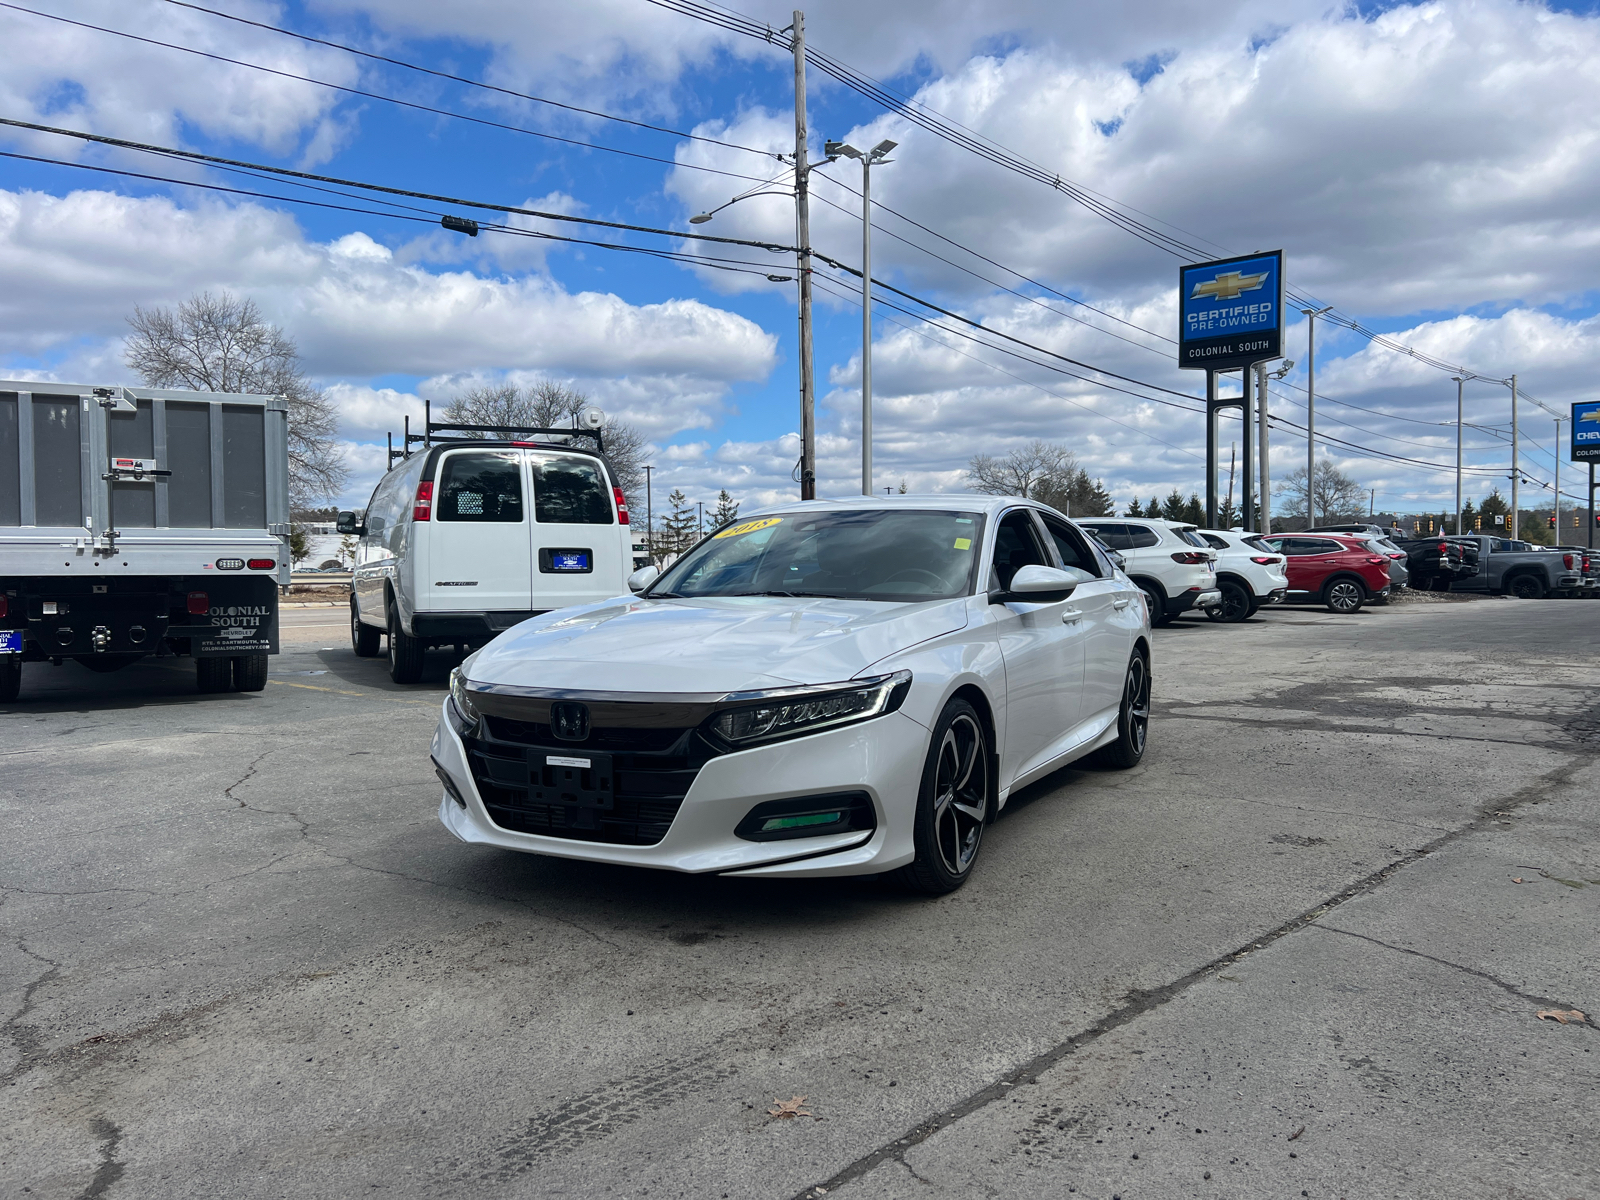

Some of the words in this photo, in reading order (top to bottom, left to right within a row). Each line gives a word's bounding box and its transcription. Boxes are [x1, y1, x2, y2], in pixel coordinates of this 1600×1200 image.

[1187, 302, 1272, 323] CERTIFIED
[1191, 313, 1267, 331] PRE-OWNED
[1189, 345, 1233, 358] COLONIAL
[1238, 340, 1269, 352] SOUTH
[722, 519, 773, 537] 2018
[202, 605, 270, 616] OLONIAL
[211, 616, 260, 627] SOUTH
